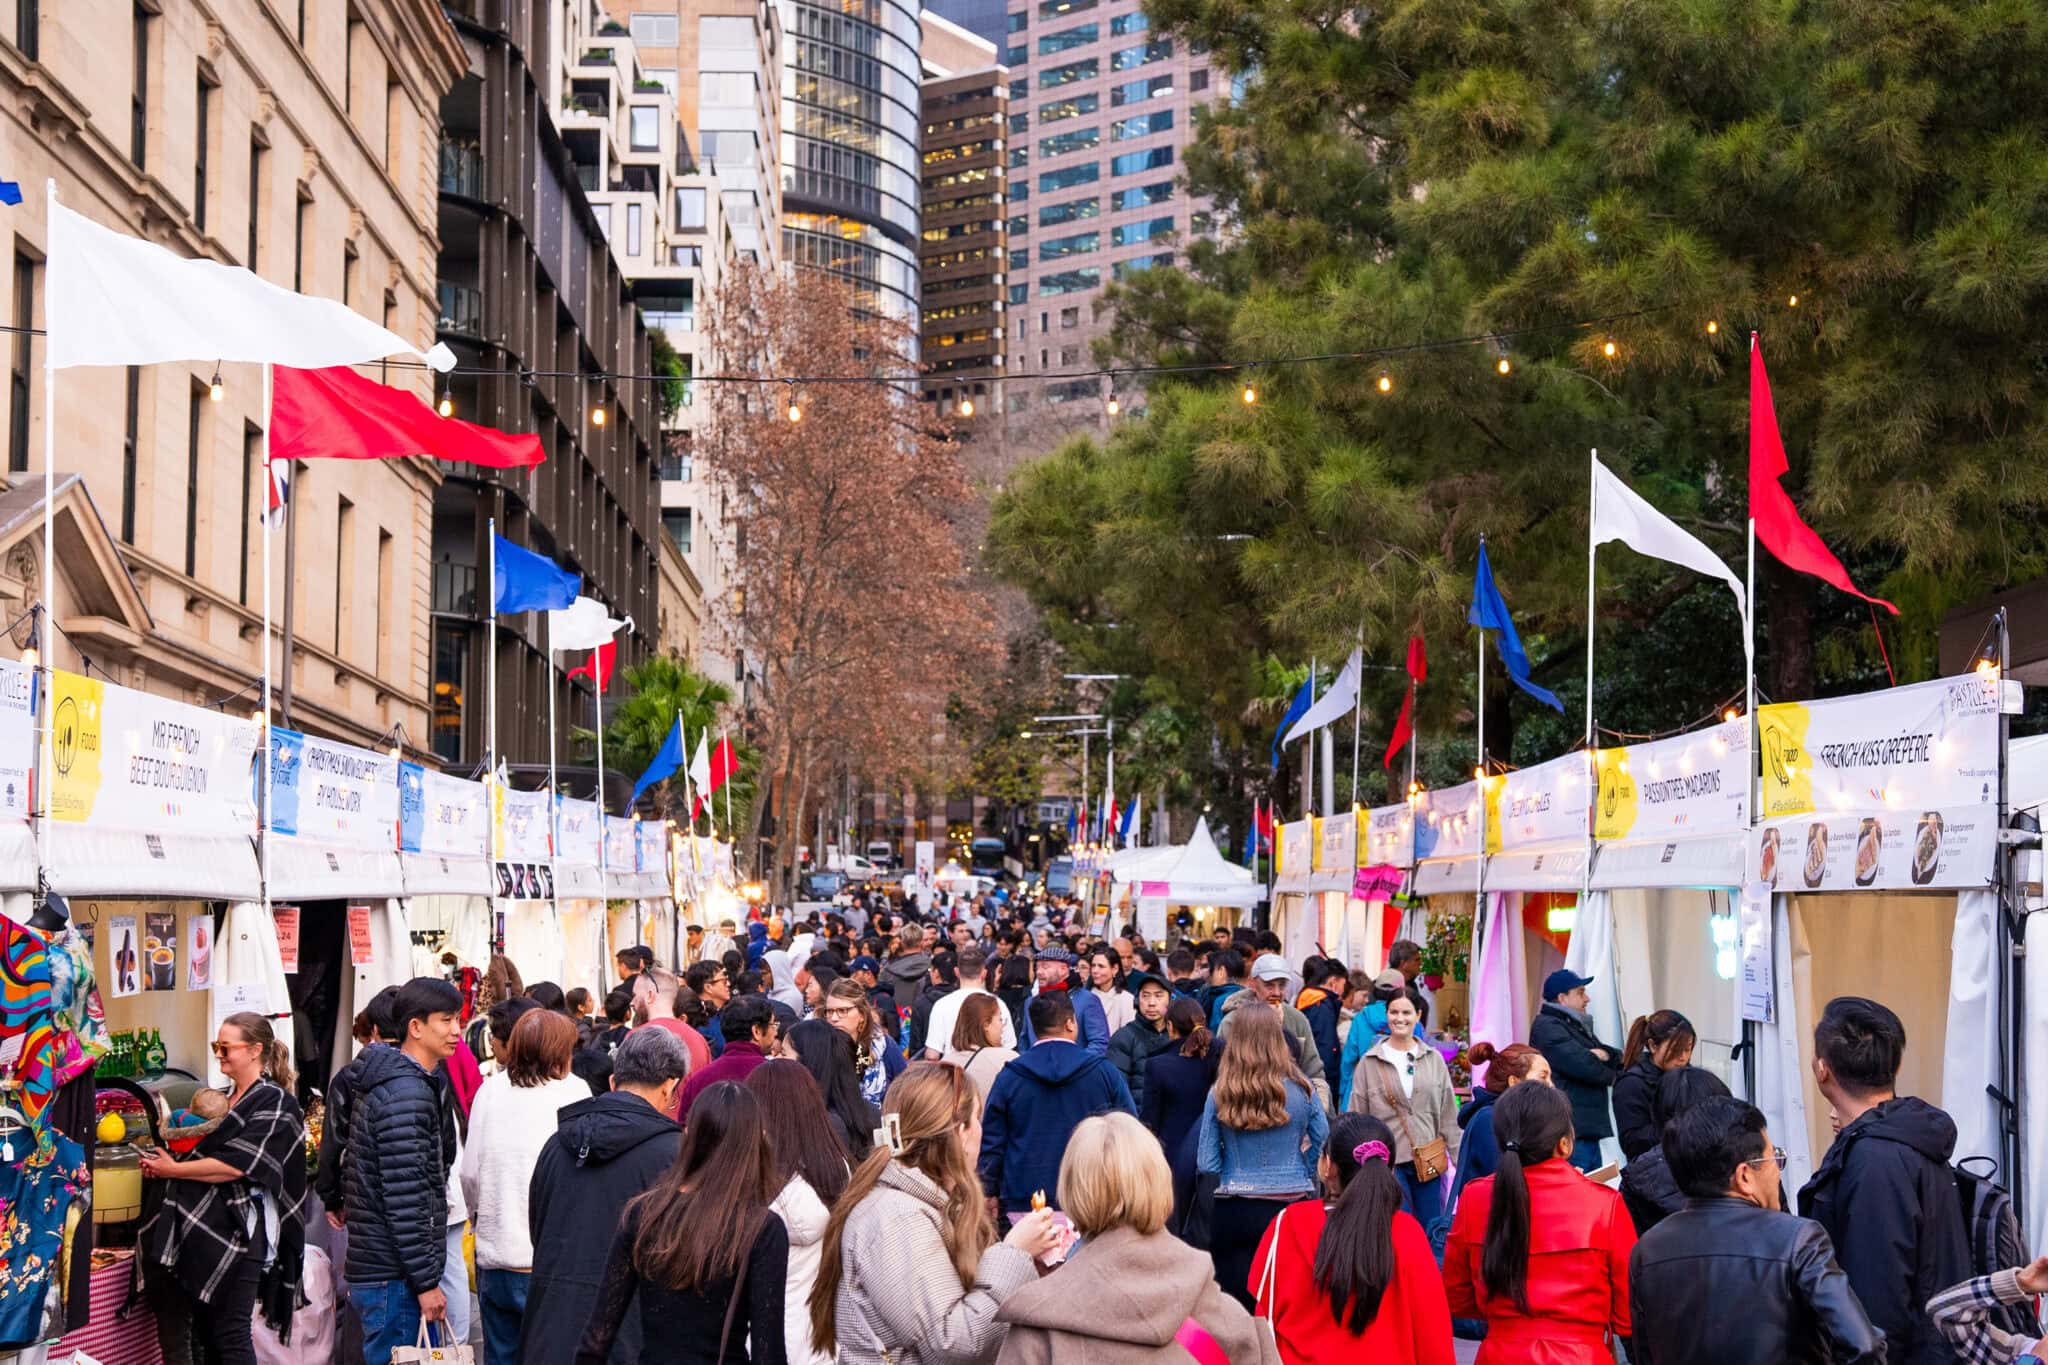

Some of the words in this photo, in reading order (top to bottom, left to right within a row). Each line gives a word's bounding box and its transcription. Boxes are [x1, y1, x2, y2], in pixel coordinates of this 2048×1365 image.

[81, 732, 97, 751] FOOD
[152, 719, 166, 749] MR
[166, 723, 201, 755] FRENCH
[1821, 743, 1859, 768] FRENCH
[1859, 739, 1885, 766] KISS
[130, 755, 155, 784] BEEF
[153, 759, 209, 794] BOURGUIGNON
[1643, 777, 1685, 804] PASSIONTREE
[1682, 769, 1721, 800] MACARONS
